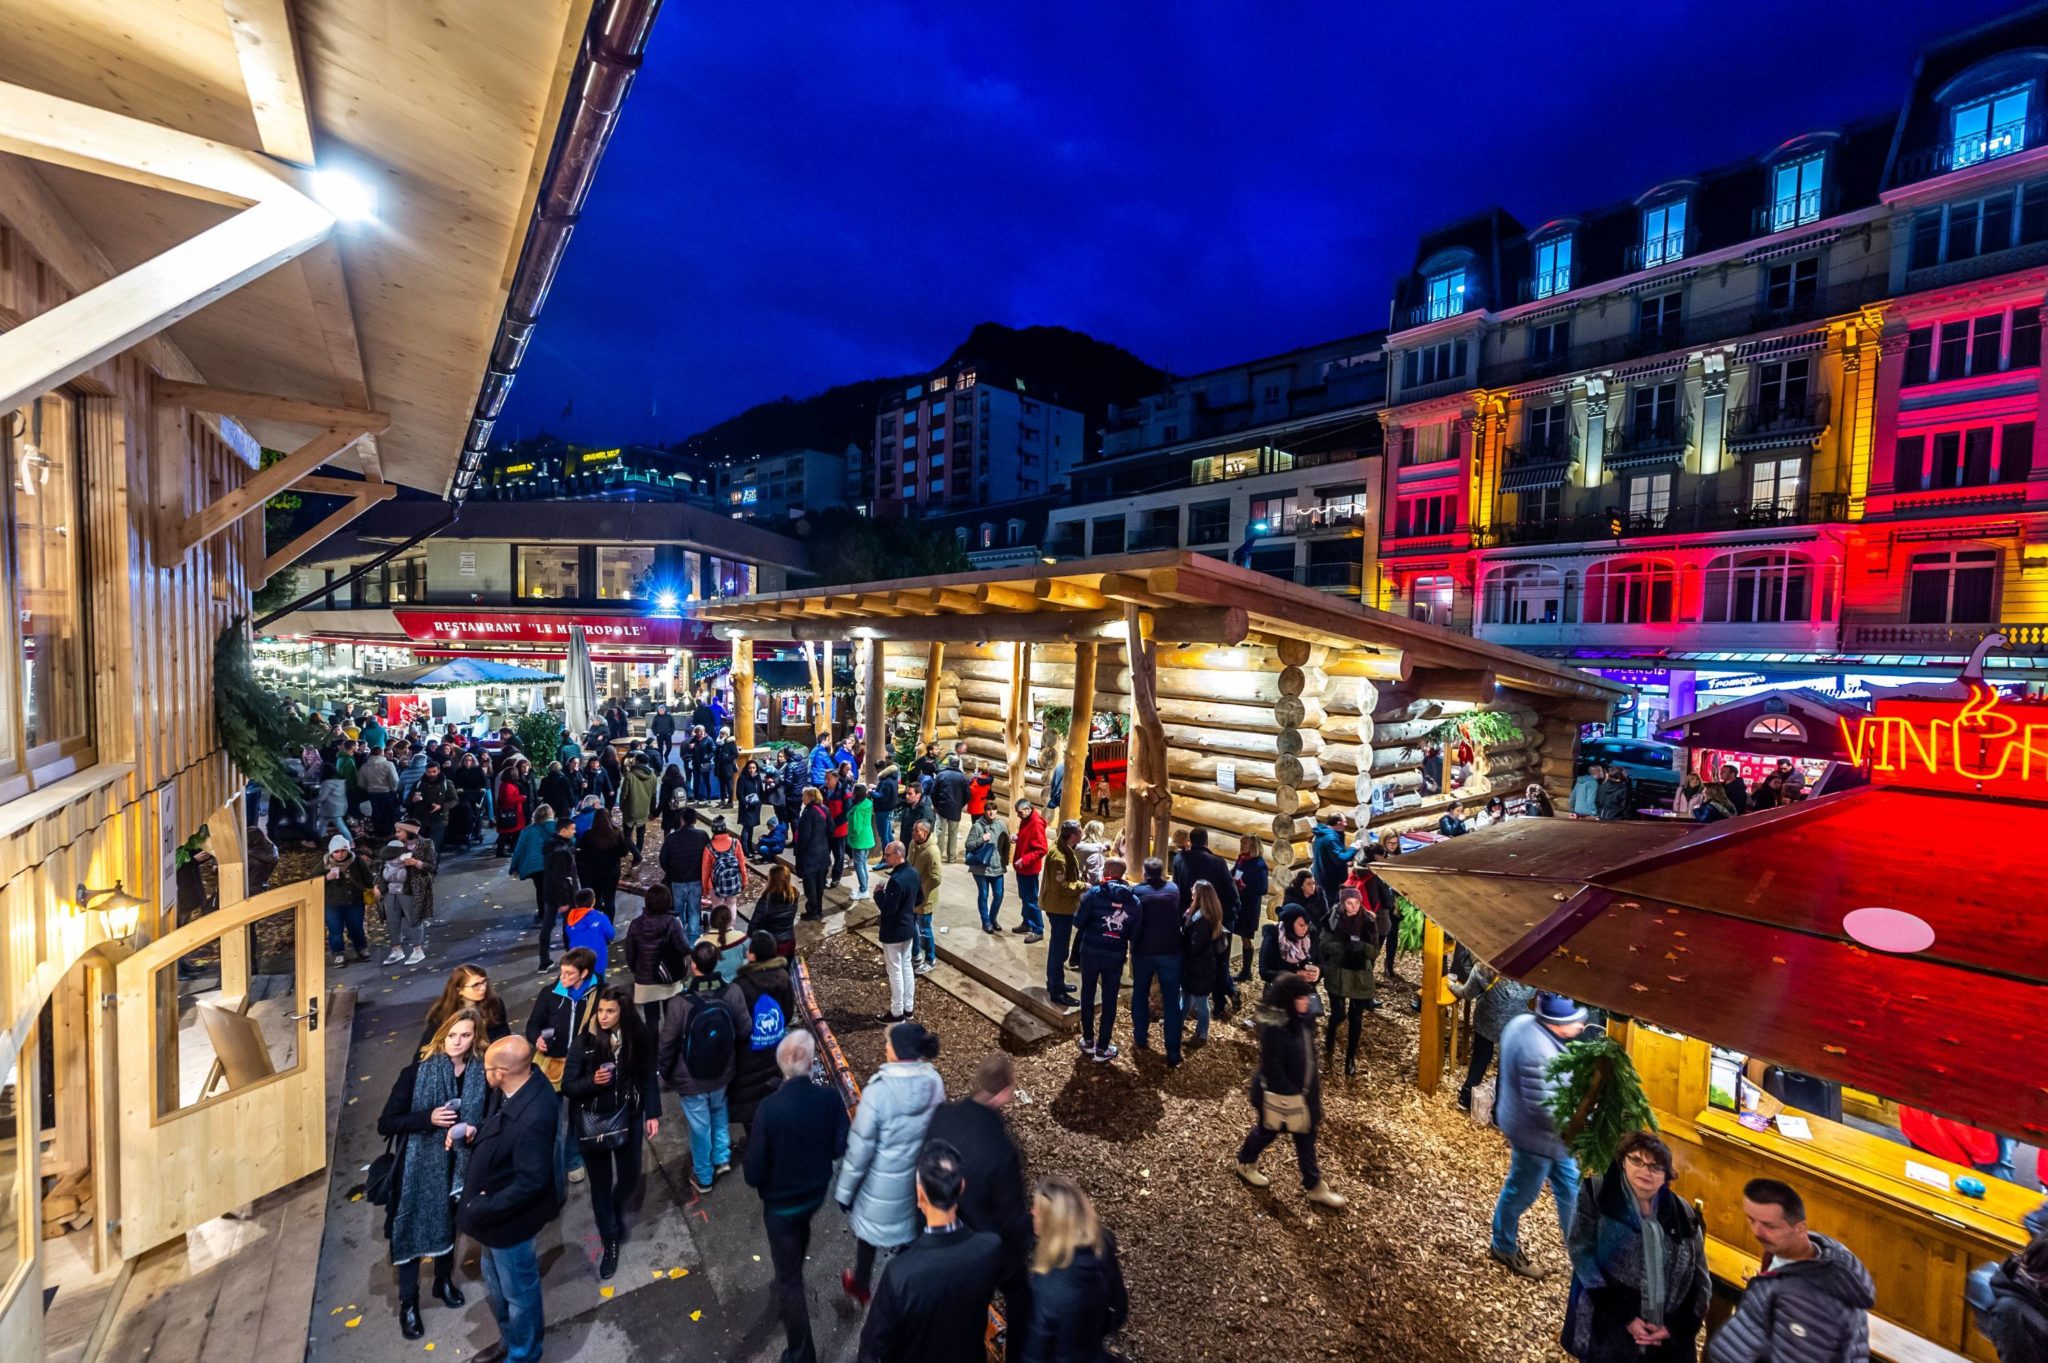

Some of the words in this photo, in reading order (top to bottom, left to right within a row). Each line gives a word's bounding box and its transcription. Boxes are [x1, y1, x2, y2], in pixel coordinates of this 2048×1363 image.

[433, 621, 522, 633] RESTAURANT
[1707, 675, 1767, 689] Fromages
[1839, 715, 1944, 774] VIN
